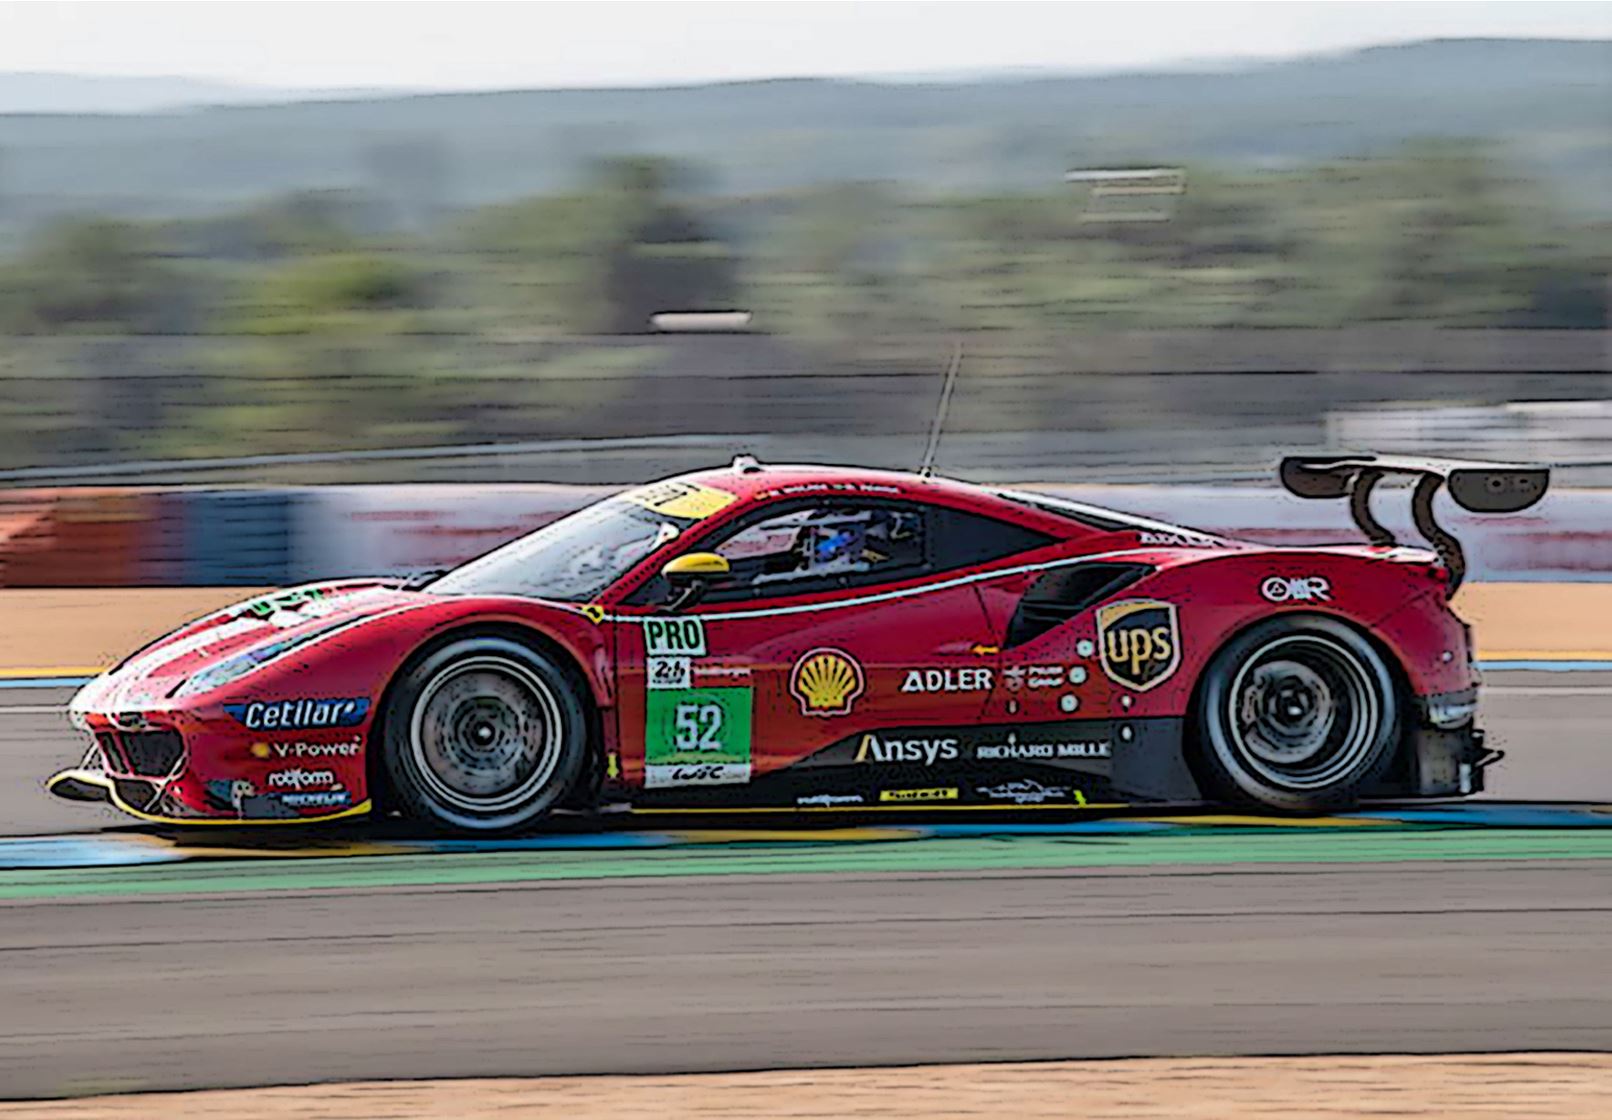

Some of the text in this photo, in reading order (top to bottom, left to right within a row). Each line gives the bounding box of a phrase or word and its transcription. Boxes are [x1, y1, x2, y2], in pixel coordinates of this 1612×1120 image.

[647, 619, 700, 650] PRO
[1107, 627, 1171, 675] ups
[901, 668, 993, 692] ADLER
[675, 704, 722, 750] 52
[853, 734, 958, 766] Ansys
